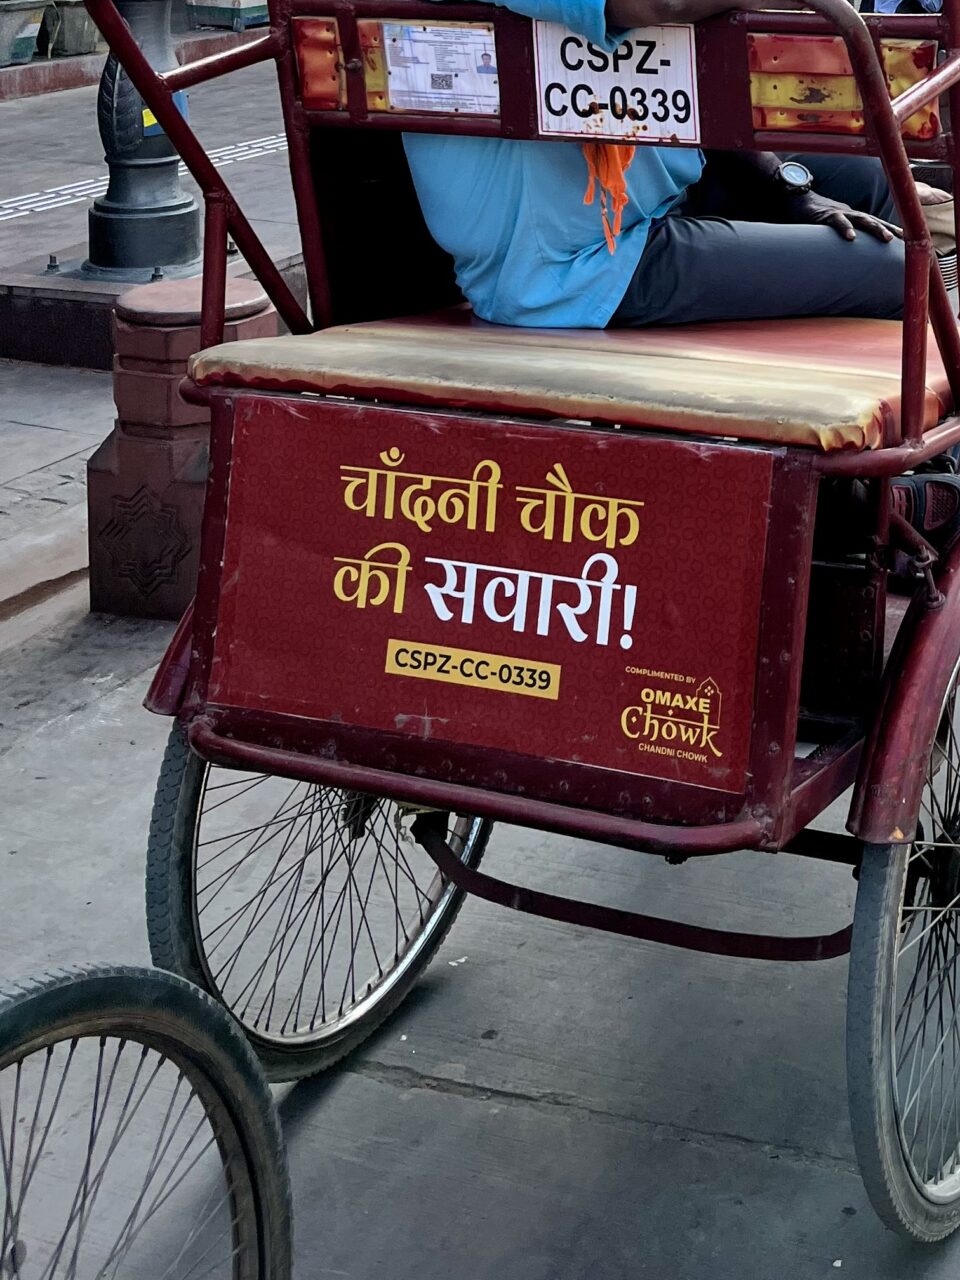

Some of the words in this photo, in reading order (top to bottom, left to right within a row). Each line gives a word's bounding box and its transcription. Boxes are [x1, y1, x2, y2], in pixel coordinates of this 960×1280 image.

[560, 36, 671, 75] CSPZ-
[544, 82, 691, 124] CC-0339
[340, 447, 503, 533] चाँदनी
[515, 463, 645, 549] चौक
[333, 542, 413, 614] की
[424, 553, 638, 649] सवारी!
[394, 648, 552, 691] CSPZ-CC-0339
[625, 665, 685, 683] COMPLIMENTED
[685, 675, 696, 684] BY
[641, 687, 711, 713] OMAXE
[620, 703, 723, 757] Chowk
[638, 742, 675, 757] CHANDNI
[676, 750, 708, 763] CHOWK
